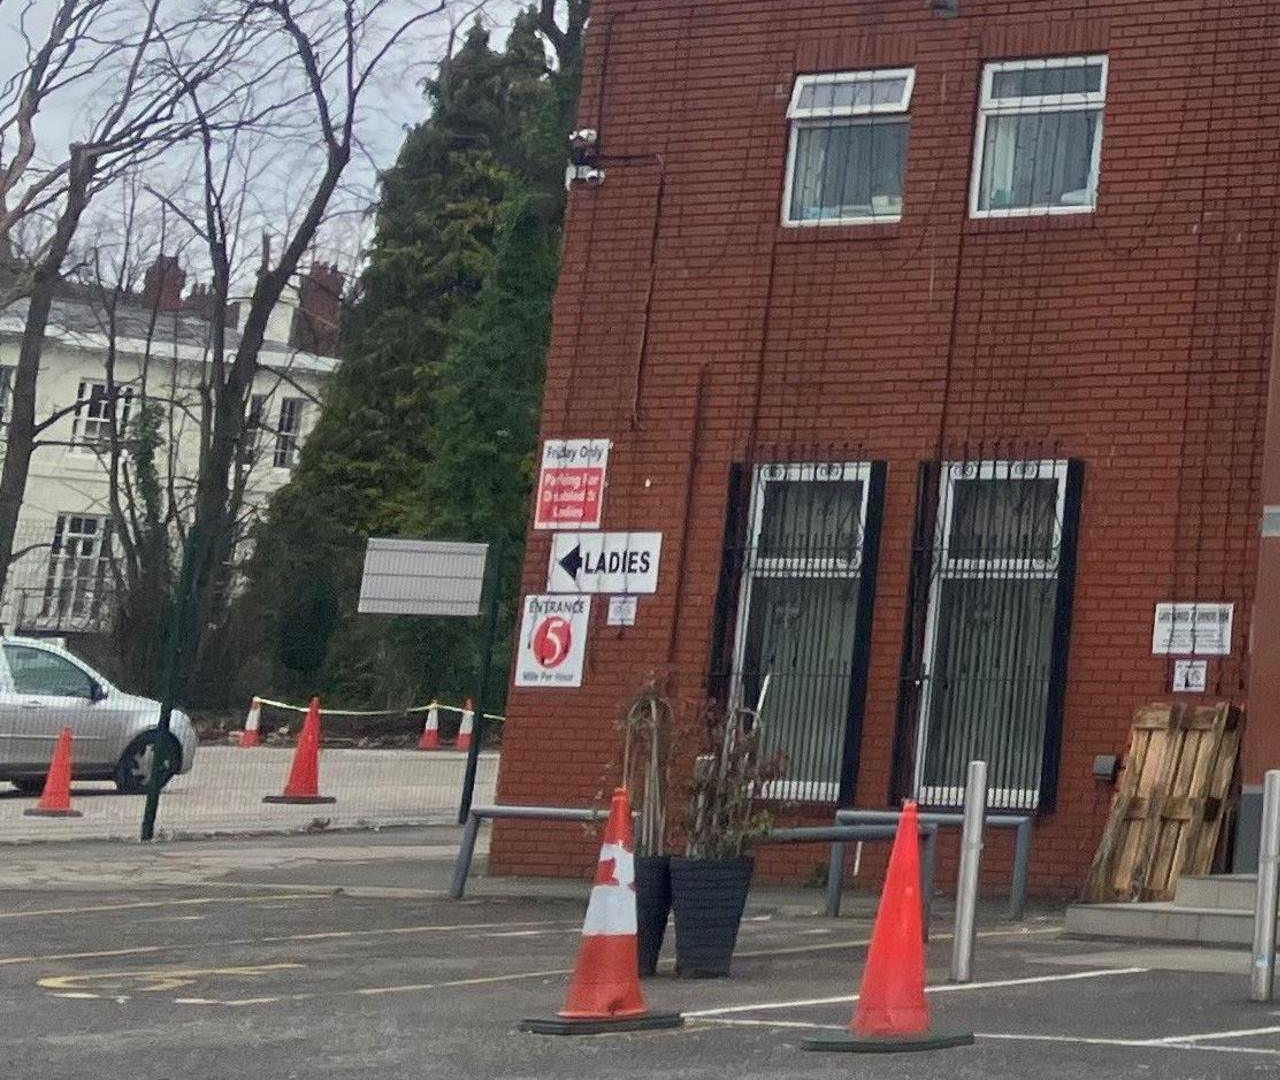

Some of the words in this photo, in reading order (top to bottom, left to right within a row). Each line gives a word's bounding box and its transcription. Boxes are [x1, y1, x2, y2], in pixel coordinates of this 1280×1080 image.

[584, 550, 651, 574] LADIES
[529, 600, 585, 614] ENTRANCE
[544, 620, 565, 666] 5
